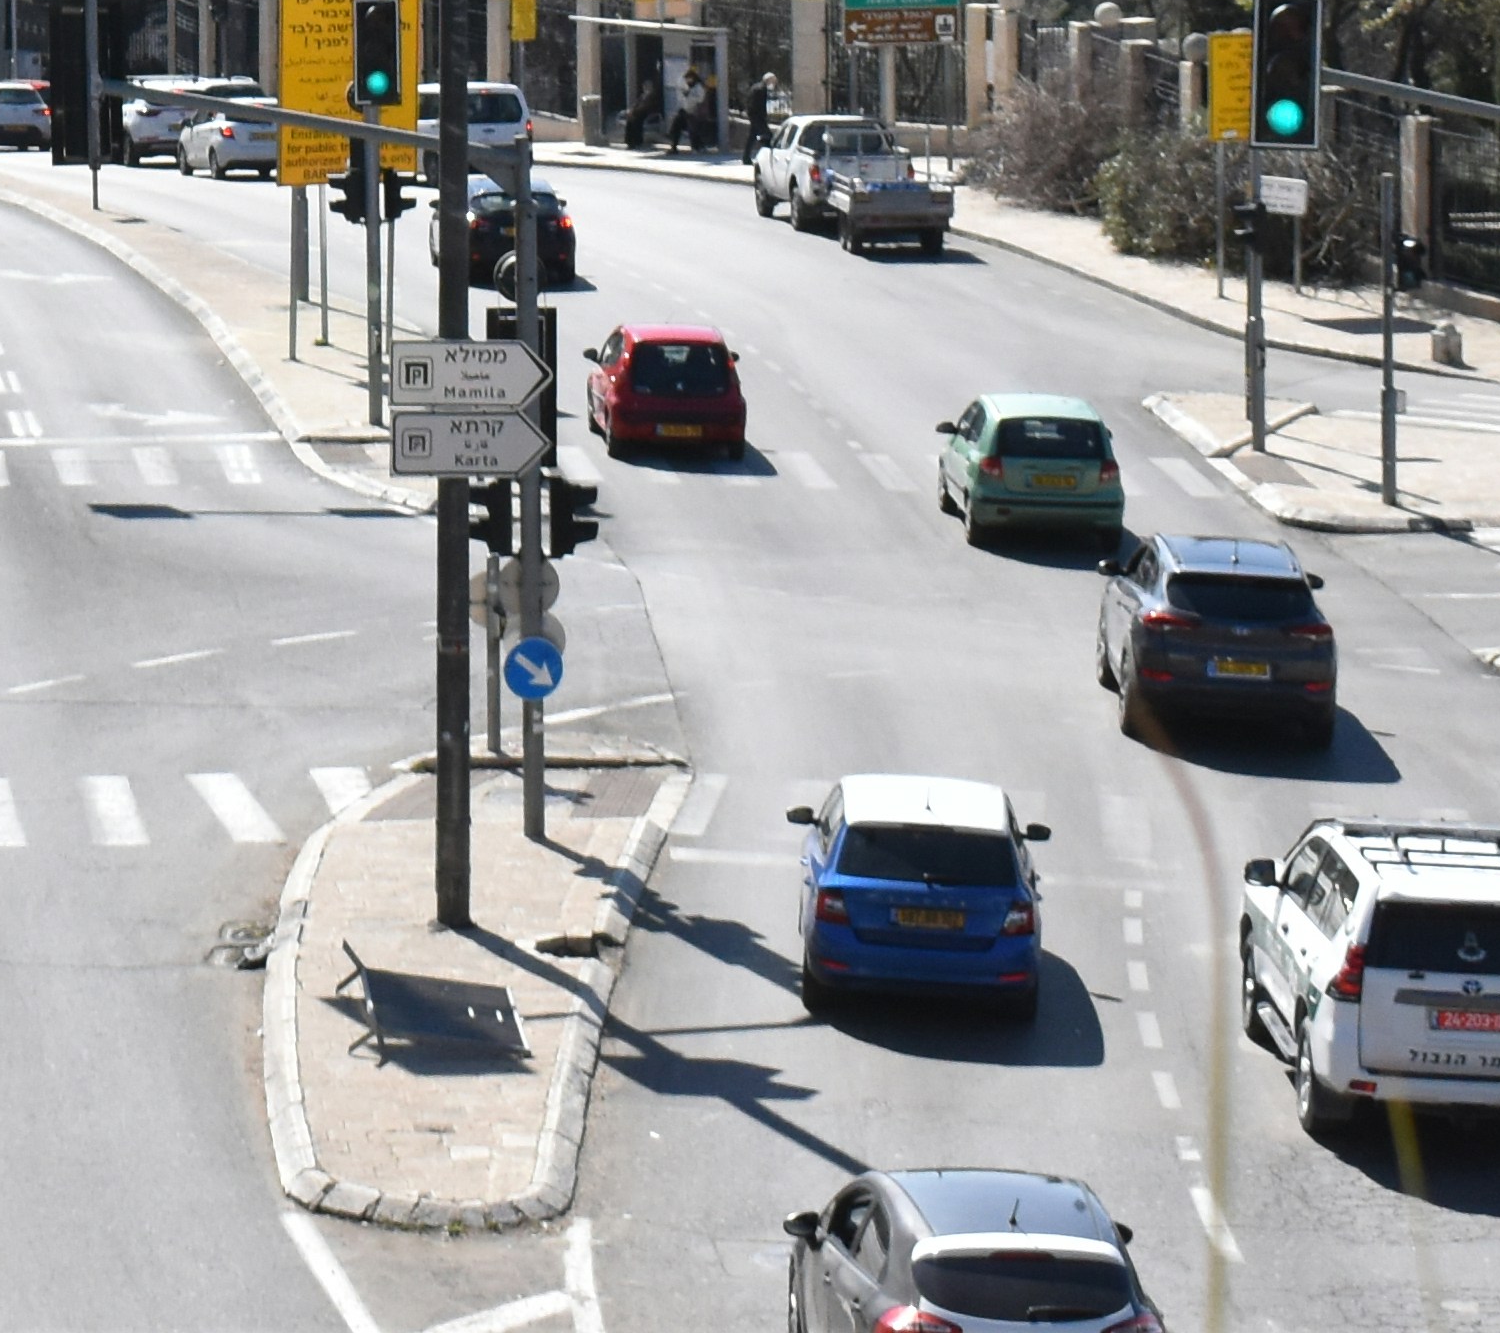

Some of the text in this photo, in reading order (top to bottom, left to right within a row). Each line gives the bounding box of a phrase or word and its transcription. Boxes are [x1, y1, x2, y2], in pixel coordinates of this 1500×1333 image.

[305, 142, 337, 155] public
[444, 345, 508, 364] ממילא
[443, 386, 506, 399] Mamila
[450, 420, 504, 438] קרתא
[454, 454, 498, 467] Karta
[1408, 1048, 1467, 1065] הגבול
